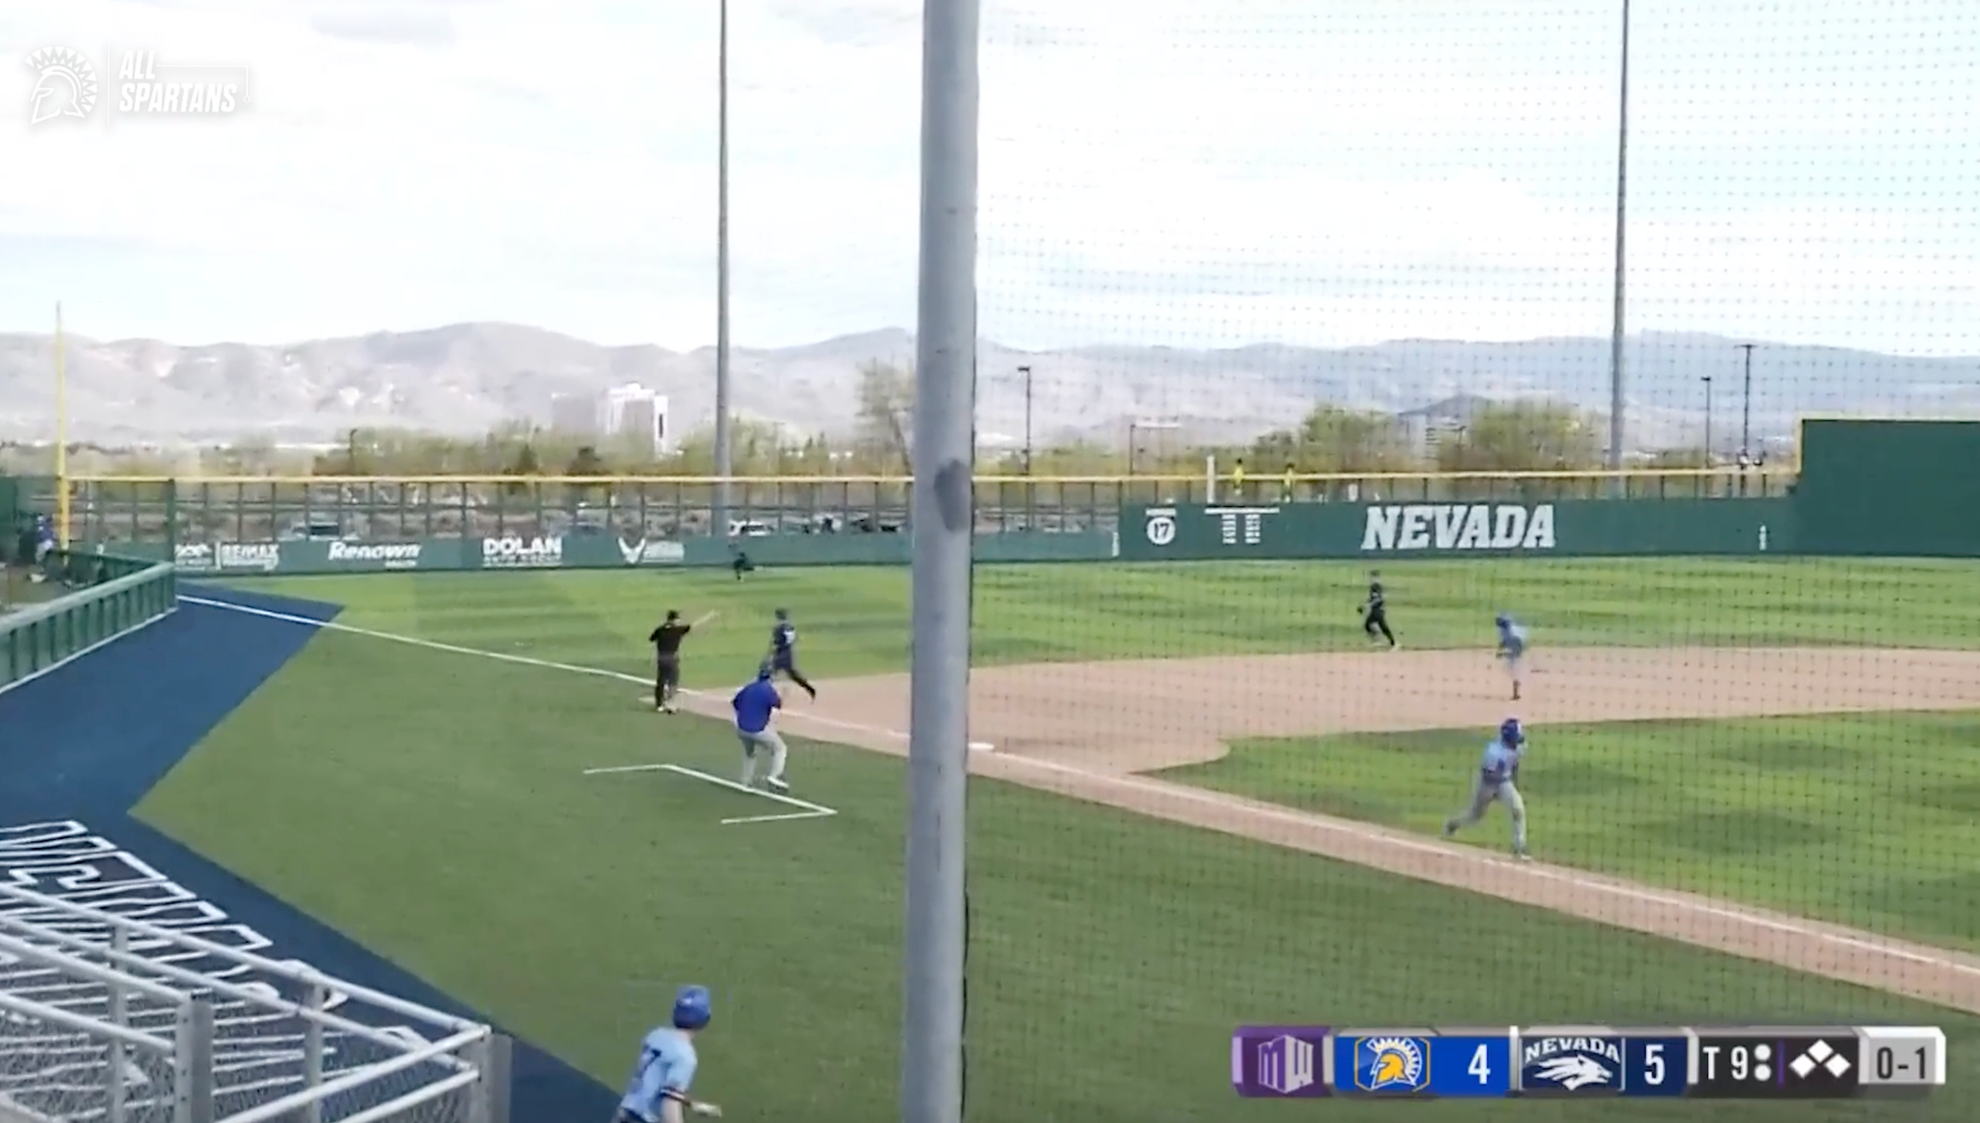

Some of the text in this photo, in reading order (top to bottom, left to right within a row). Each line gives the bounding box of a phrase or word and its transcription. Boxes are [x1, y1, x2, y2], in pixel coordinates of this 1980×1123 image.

[1153, 523, 1170, 539] 17
[1361, 504, 1555, 550] NEVADA
[327, 541, 422, 561] Renown
[482, 537, 562, 556] DOLAN
